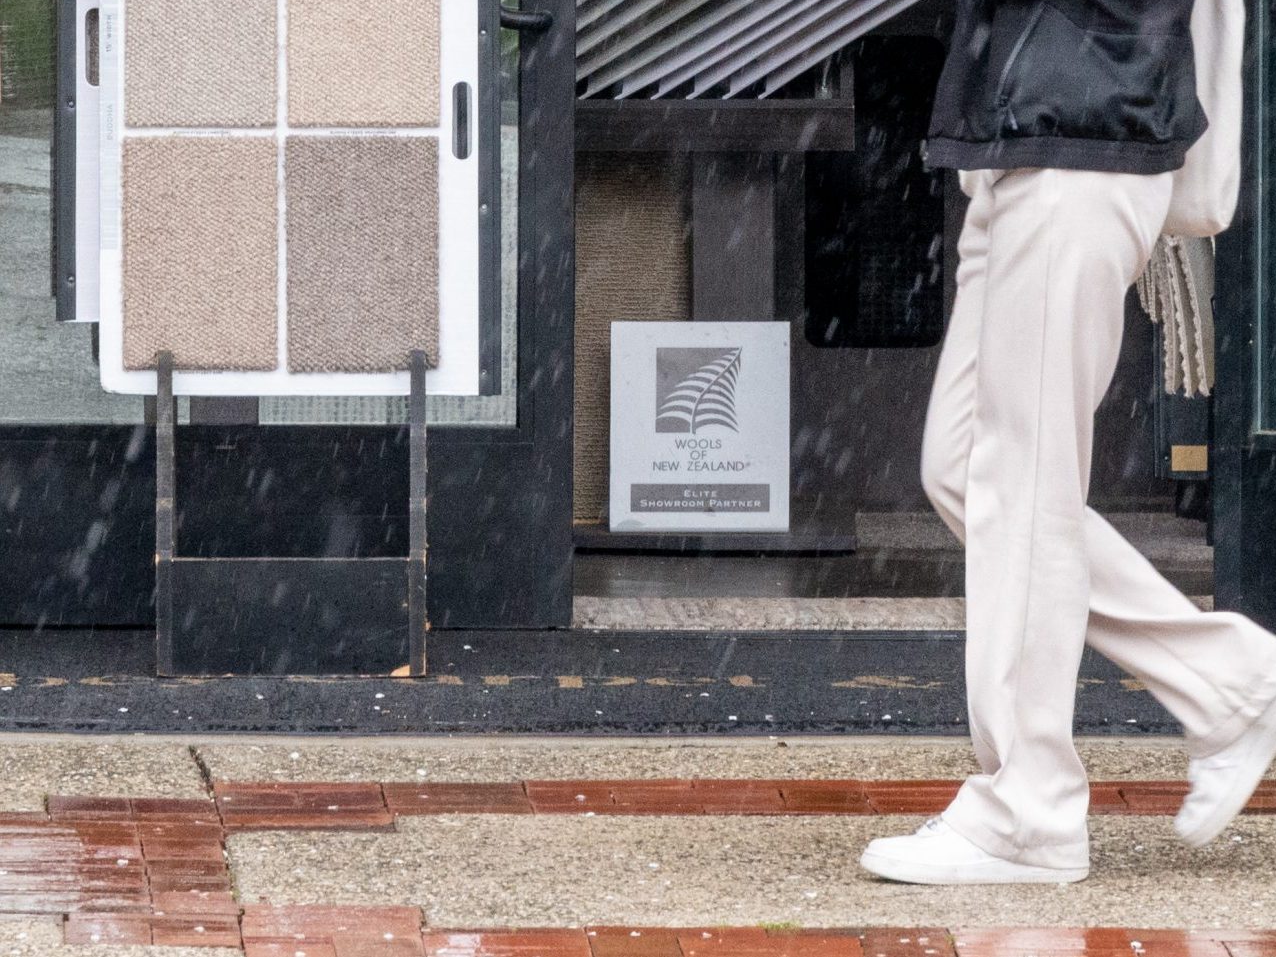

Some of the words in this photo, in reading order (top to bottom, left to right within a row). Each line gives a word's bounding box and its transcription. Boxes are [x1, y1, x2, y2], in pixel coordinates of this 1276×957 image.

[674, 439, 722, 449] WOOLS
[690, 450, 707, 460] OF
[652, 461, 679, 471] NEW
[687, 461, 746, 471] ZEALAND
[683, 489, 718, 498] ELITE
[640, 499, 705, 508] SHOWROOM
[709, 499, 761, 508] PARTNER
